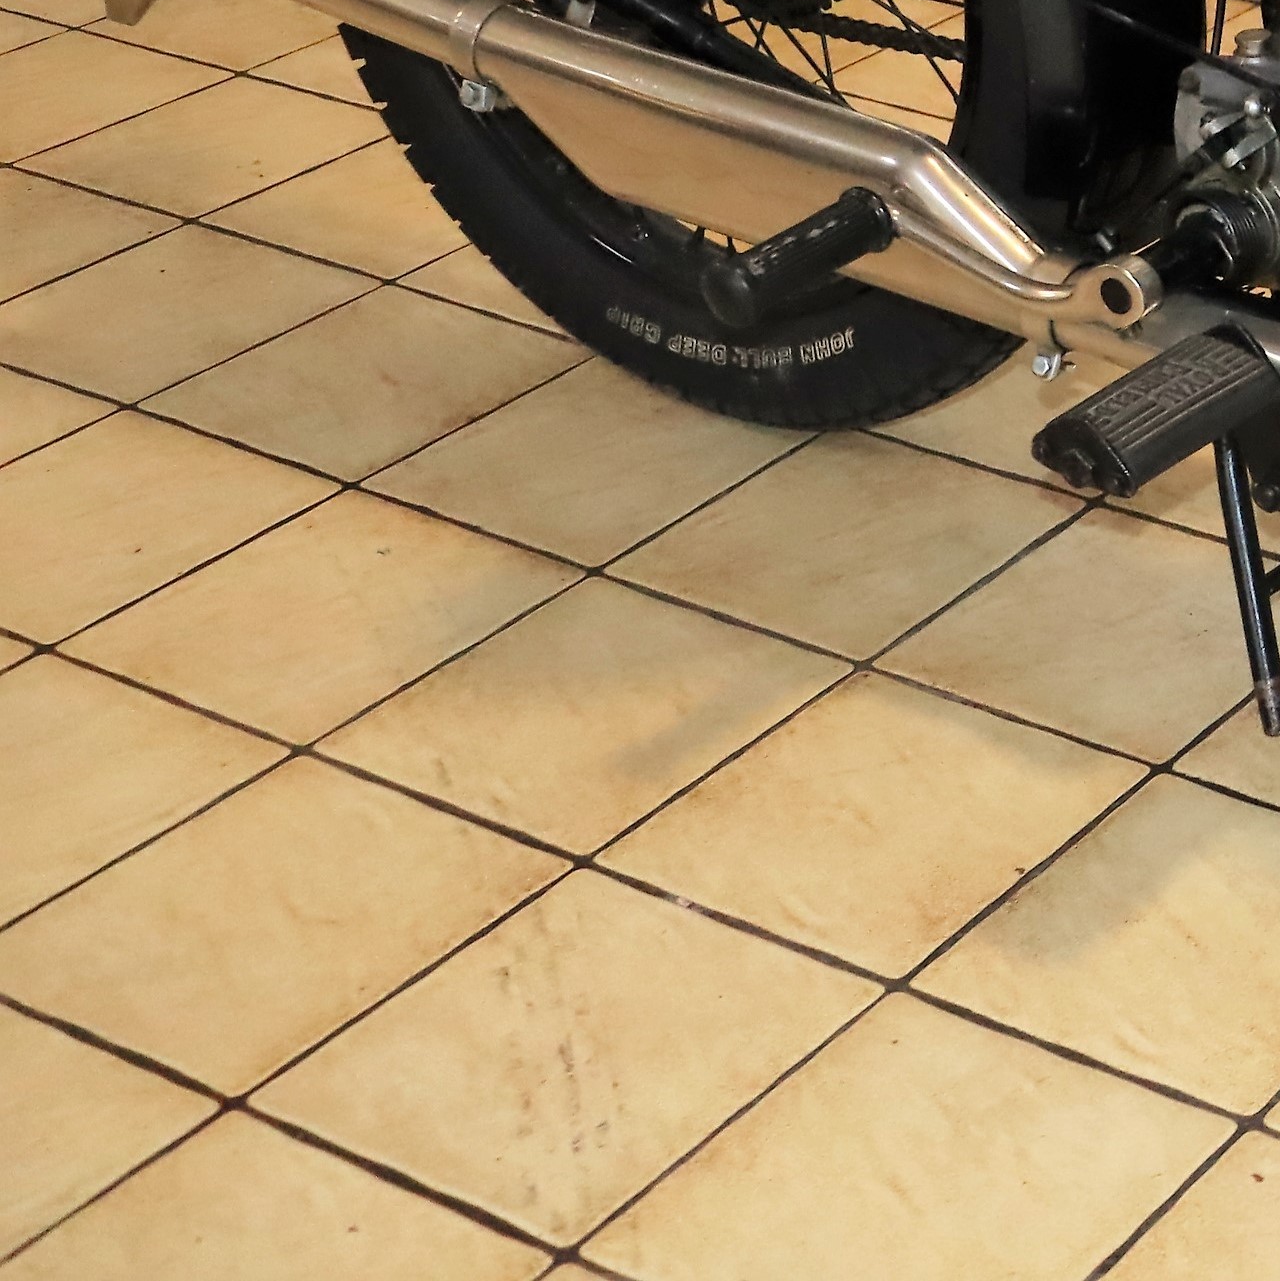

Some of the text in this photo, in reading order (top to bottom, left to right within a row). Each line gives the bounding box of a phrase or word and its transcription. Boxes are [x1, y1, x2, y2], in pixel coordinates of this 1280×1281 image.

[606, 305, 662, 345] GRIP
[667, 334, 728, 366] DEEP
[799, 326, 855, 365] JOHN
